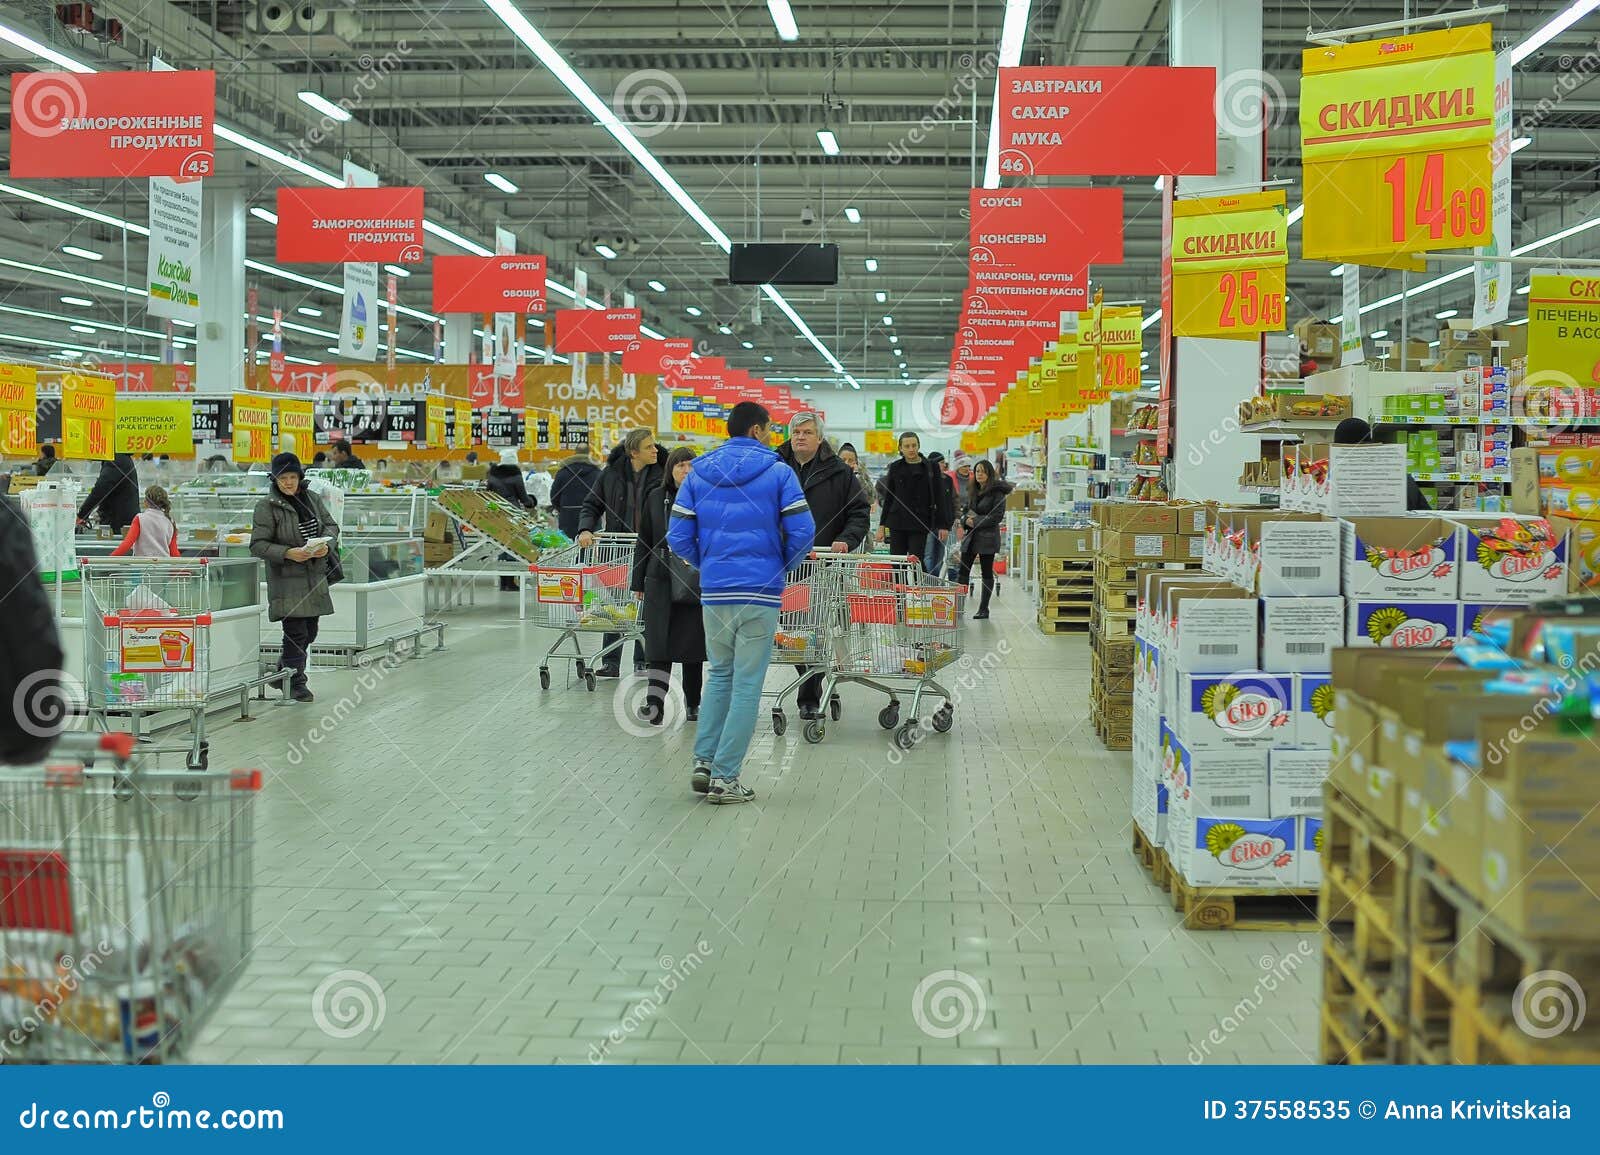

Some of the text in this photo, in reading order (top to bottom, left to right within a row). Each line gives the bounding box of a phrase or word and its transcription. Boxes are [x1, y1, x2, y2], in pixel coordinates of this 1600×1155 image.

[1011, 80, 1102, 94] ЗАВТРАКИ
[1011, 106, 1070, 119] САХАР
[1318, 87, 1475, 132] СКИДКИ!
[60, 115, 203, 130] ЗАМОРОЖЕННЫЕ
[110, 134, 202, 150] ПРОДУКТЫ
[1011, 132, 1062, 146] МУКА
[188, 160, 209, 173] 45
[1001, 158, 1024, 172] 46
[979, 198, 1022, 207] СОУСЫ
[311, 218, 416, 230] ЗАМОРОЖЕННЫЕ
[348, 232, 415, 243] ПРОДУКТЫ
[979, 234, 1047, 245] КОНСЕРВЫ
[1183, 230, 1277, 256] СКИДКИ!
[404, 250, 421, 261] 43
[972, 252, 989, 263] 44
[500, 261, 540, 271] ФРУКТЫ
[976, 273, 1073, 283] МАКАРОНЫ, КРУПЫ
[502, 289, 540, 299] ОВОЩИ
[976, 286, 1085, 297] РАСТИТЕЛЬНОЕ МАСЛО
[531, 302, 544, 311] 41
[969, 301, 983, 309] 42
[606, 313, 637, 321] ФРУКТЫ
[1536, 308, 1600, 323] ПЕЧЕНЬ
[967, 318, 1007, 328] СРЕДСТВА
[1008, 319, 1025, 328] ДЛЯ
[608, 333, 637, 342] ОВОЩИ
[962, 330, 974, 338] 40
[1558, 327, 1568, 338] В
[587, 405, 629, 423] ВЕС
[1391, 624, 1434, 648] Ciko
[1226, 699, 1270, 725] Ciko
[1230, 839, 1275, 865] Ciko
